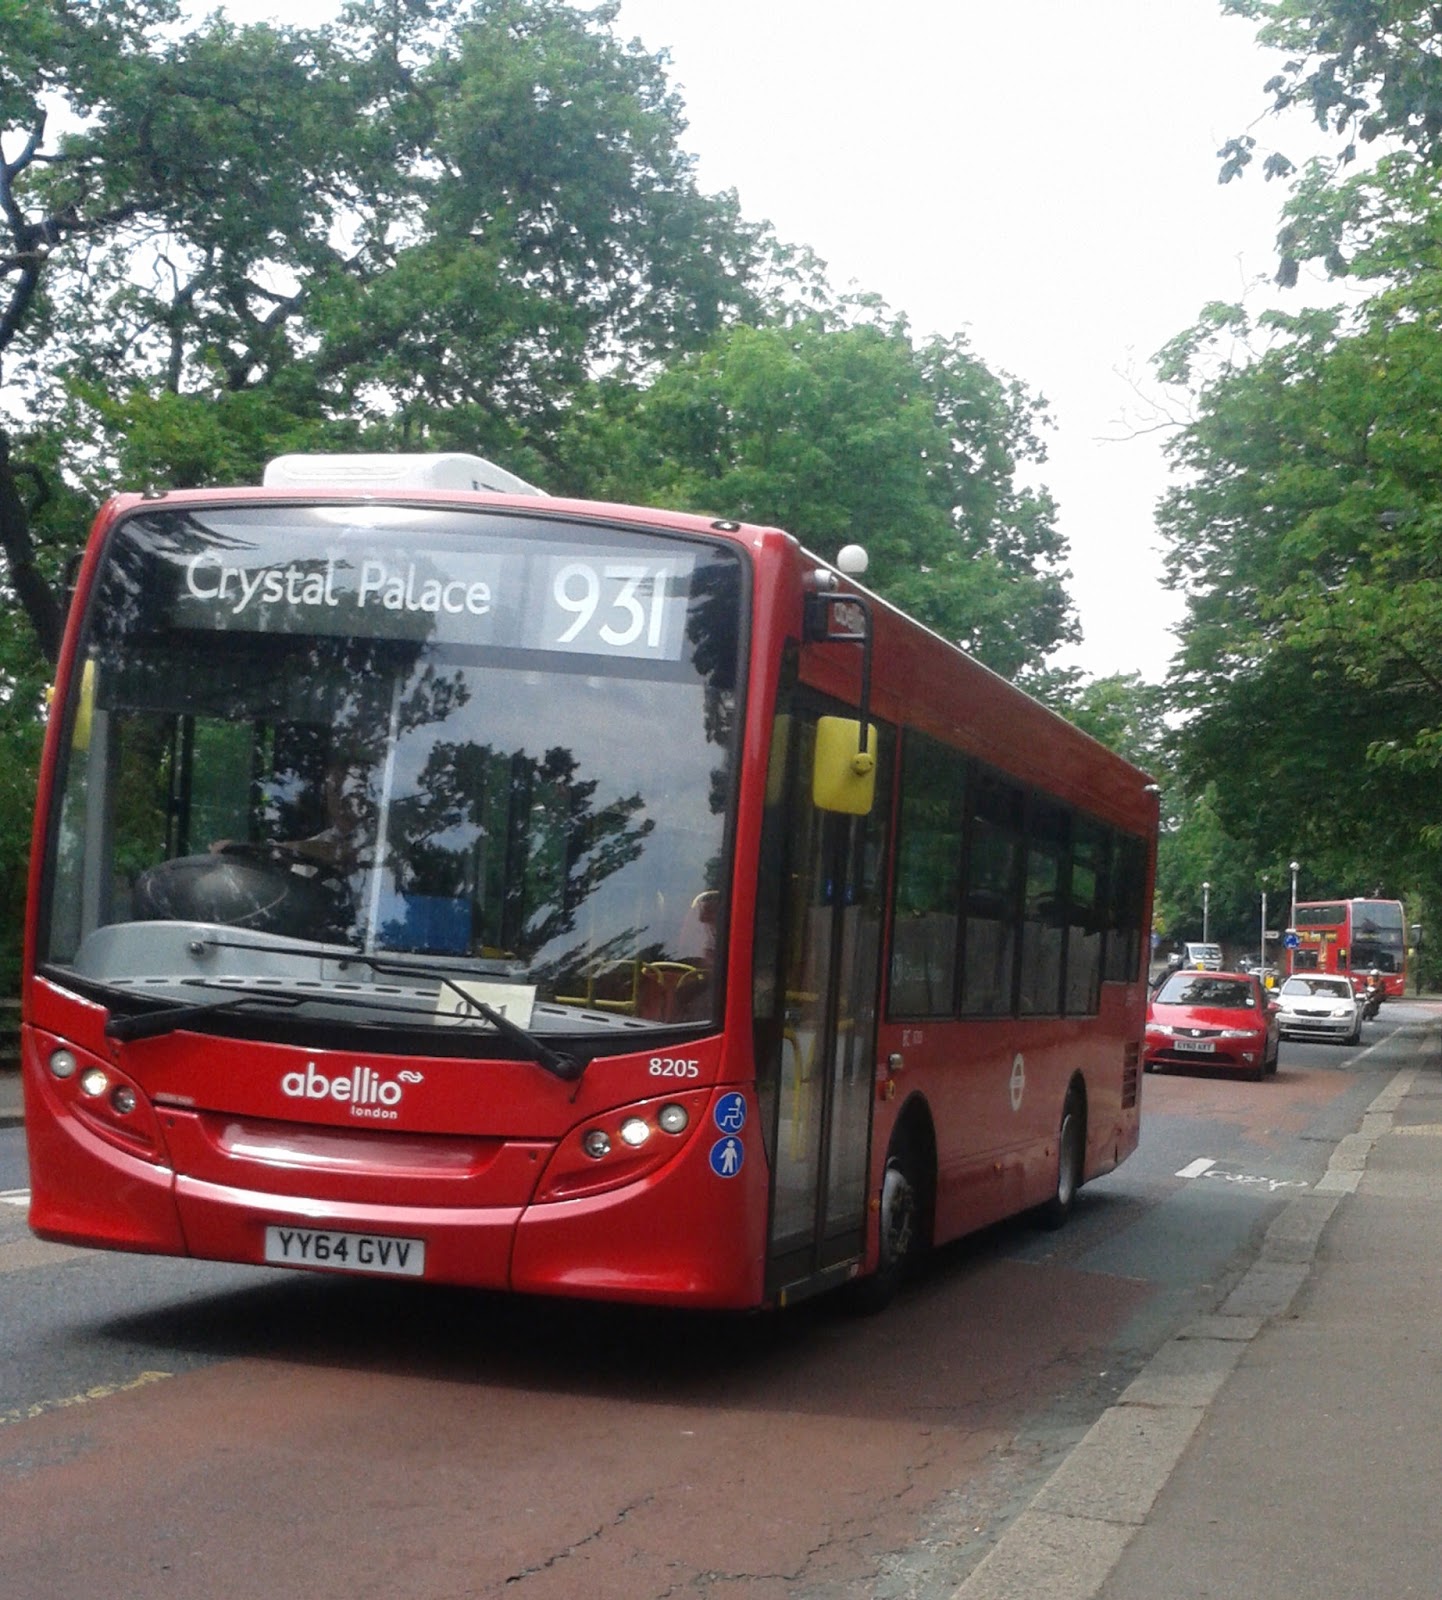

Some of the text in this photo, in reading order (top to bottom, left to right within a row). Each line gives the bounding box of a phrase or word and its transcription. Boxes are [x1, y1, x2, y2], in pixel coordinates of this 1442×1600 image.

[186, 552, 491, 616] Crystal Palace
[553, 562, 667, 648] 931
[281, 1061, 402, 1105] abellio
[649, 1057, 699, 1078] 8205
[351, 1105, 398, 1119] london
[279, 1231, 411, 1267] YY64 GVV
